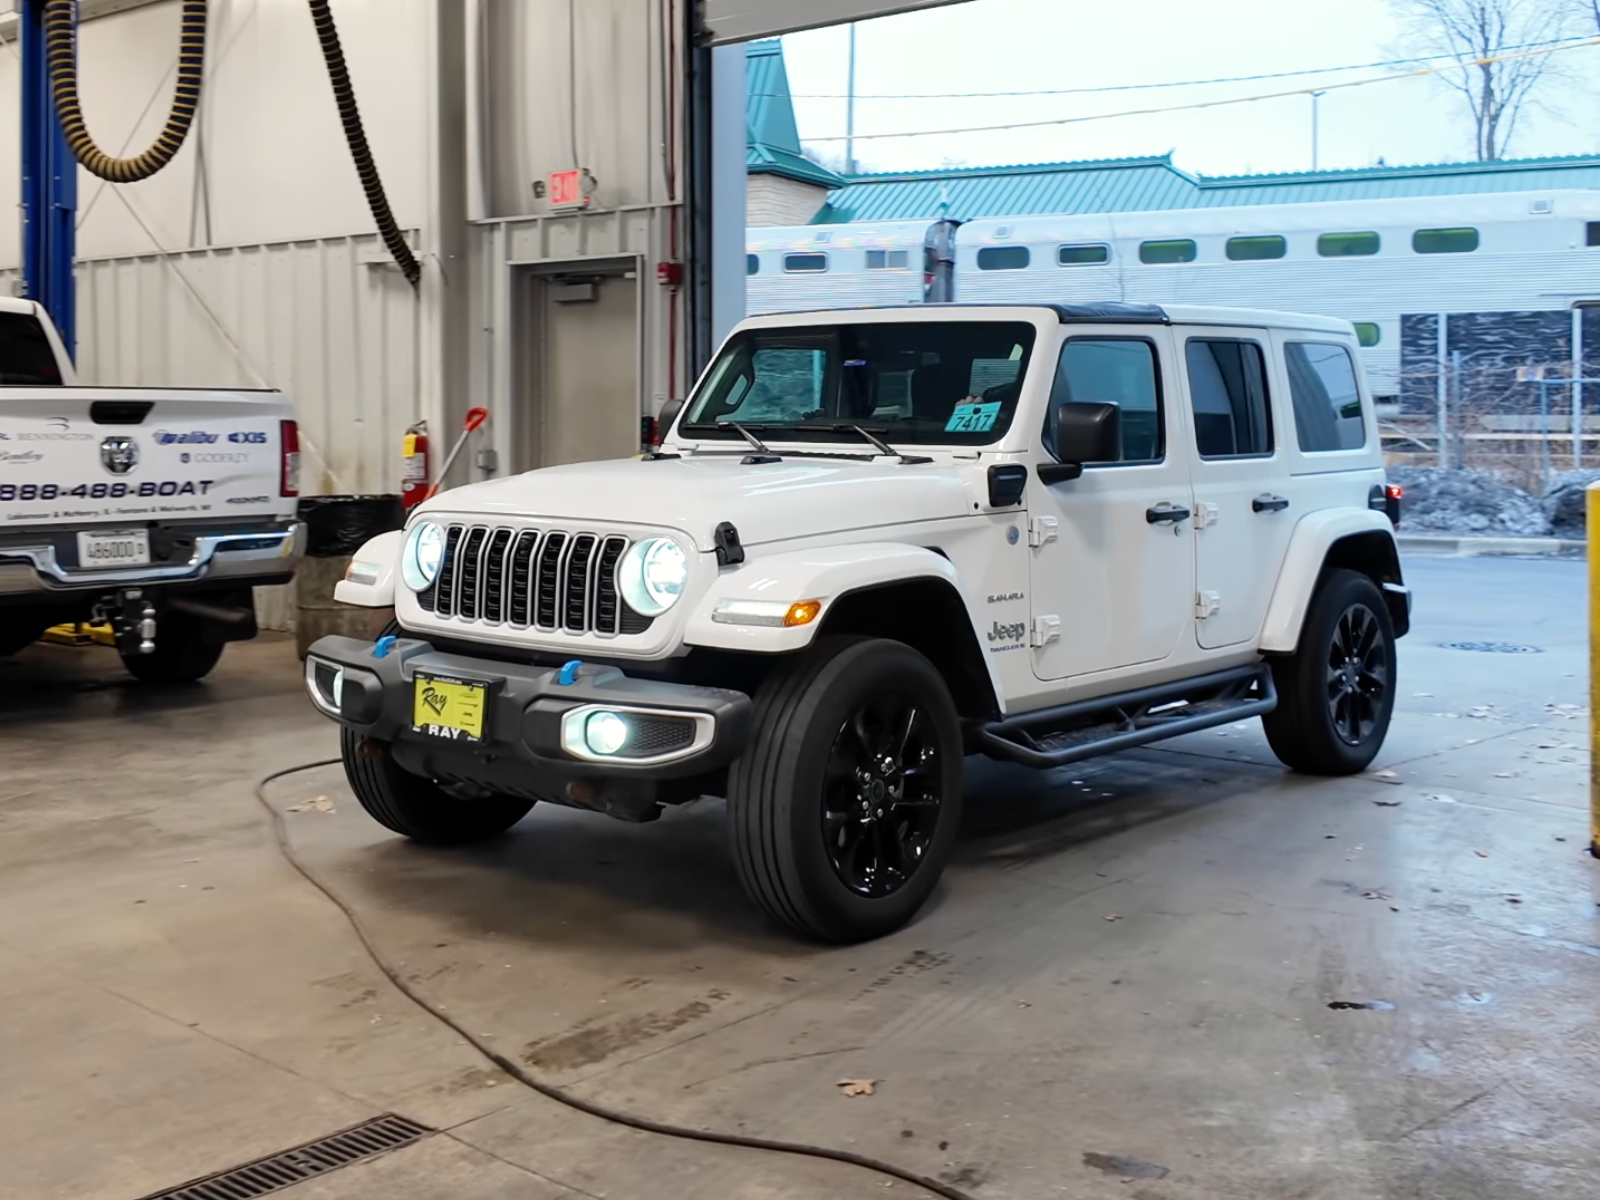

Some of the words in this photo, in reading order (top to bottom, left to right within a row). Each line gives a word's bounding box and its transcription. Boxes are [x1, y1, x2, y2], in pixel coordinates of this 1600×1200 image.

[551, 172, 578, 203] EXIT
[953, 414, 992, 431] 7417
[987, 592, 1024, 604] SAHARA
[987, 620, 1025, 642] Jeep
[422, 687, 448, 717] Ray
[428, 724, 461, 739] RAY
